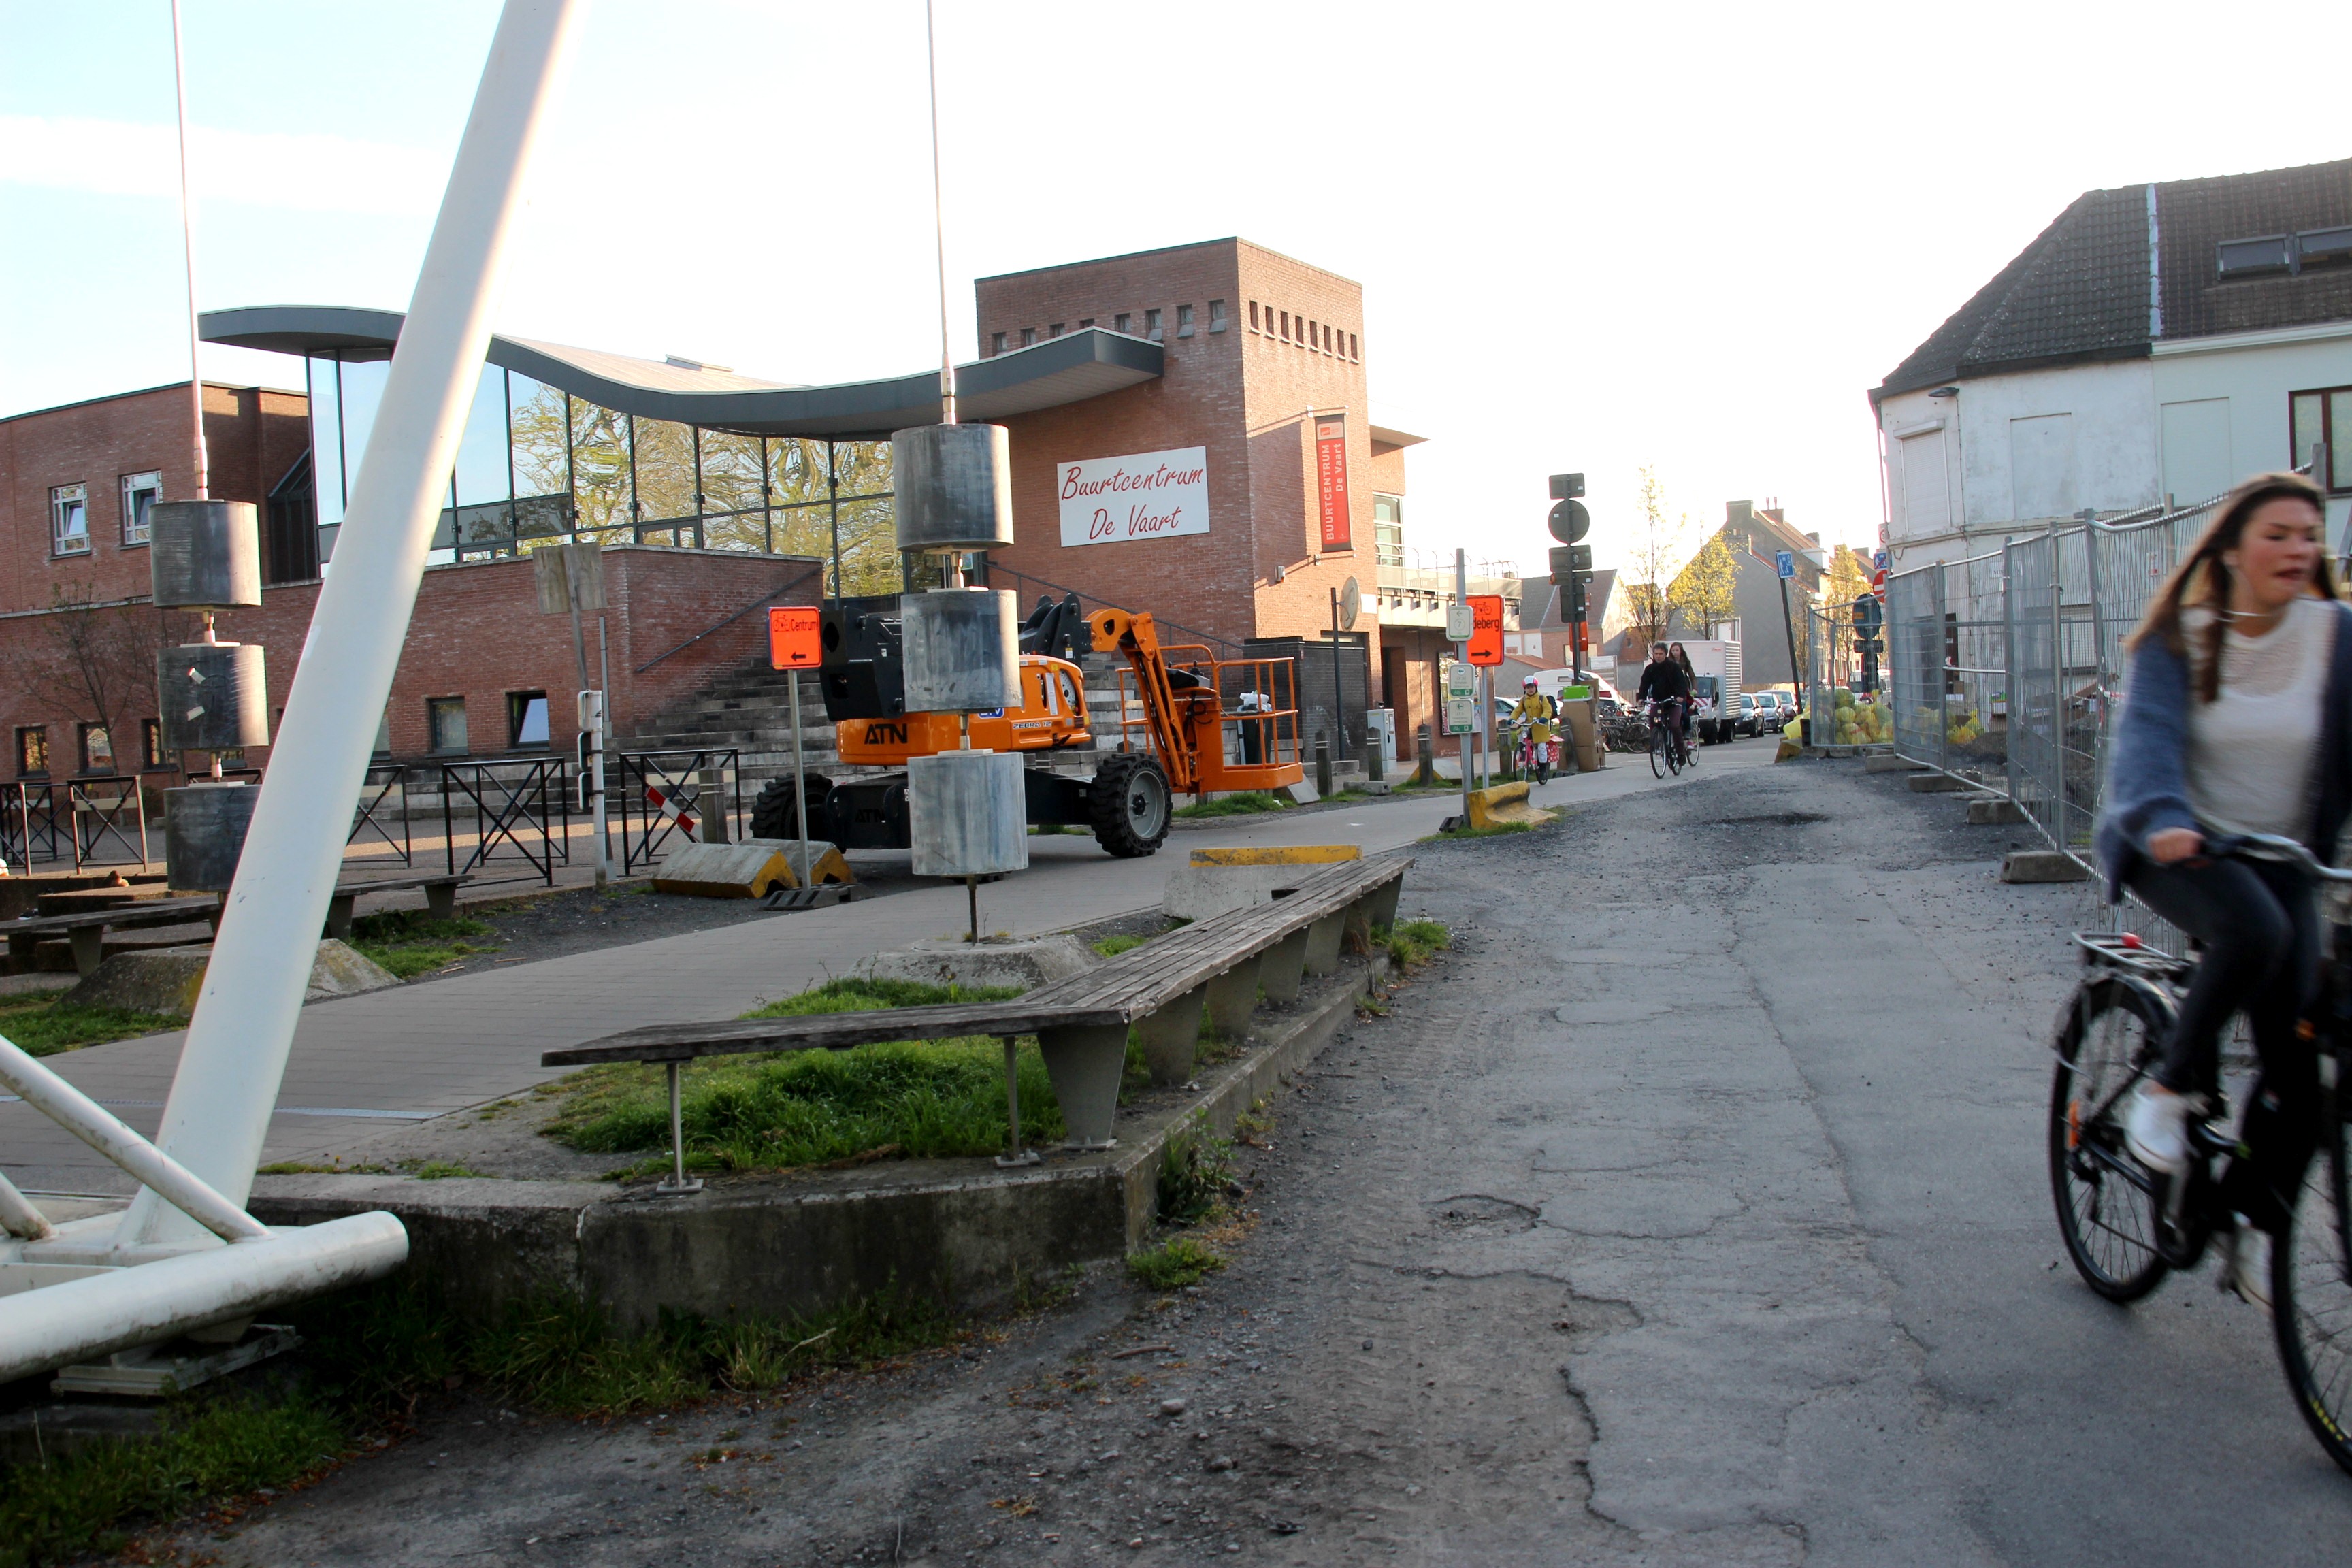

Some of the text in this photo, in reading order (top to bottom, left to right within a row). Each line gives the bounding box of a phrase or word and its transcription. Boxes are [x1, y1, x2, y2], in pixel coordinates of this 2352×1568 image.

[1333, 443, 1343, 474] Vaart
[1062, 463, 1204, 500] Buurtcentrum
[1322, 444, 1335, 540] BUURTCENTRUM
[1335, 478, 1344, 492] De
[1089, 504, 1181, 540] De Vaart
[791, 619, 817, 632] Centrum
[1473, 617, 1500, 632] deberg
[864, 723, 908, 745] ATN
